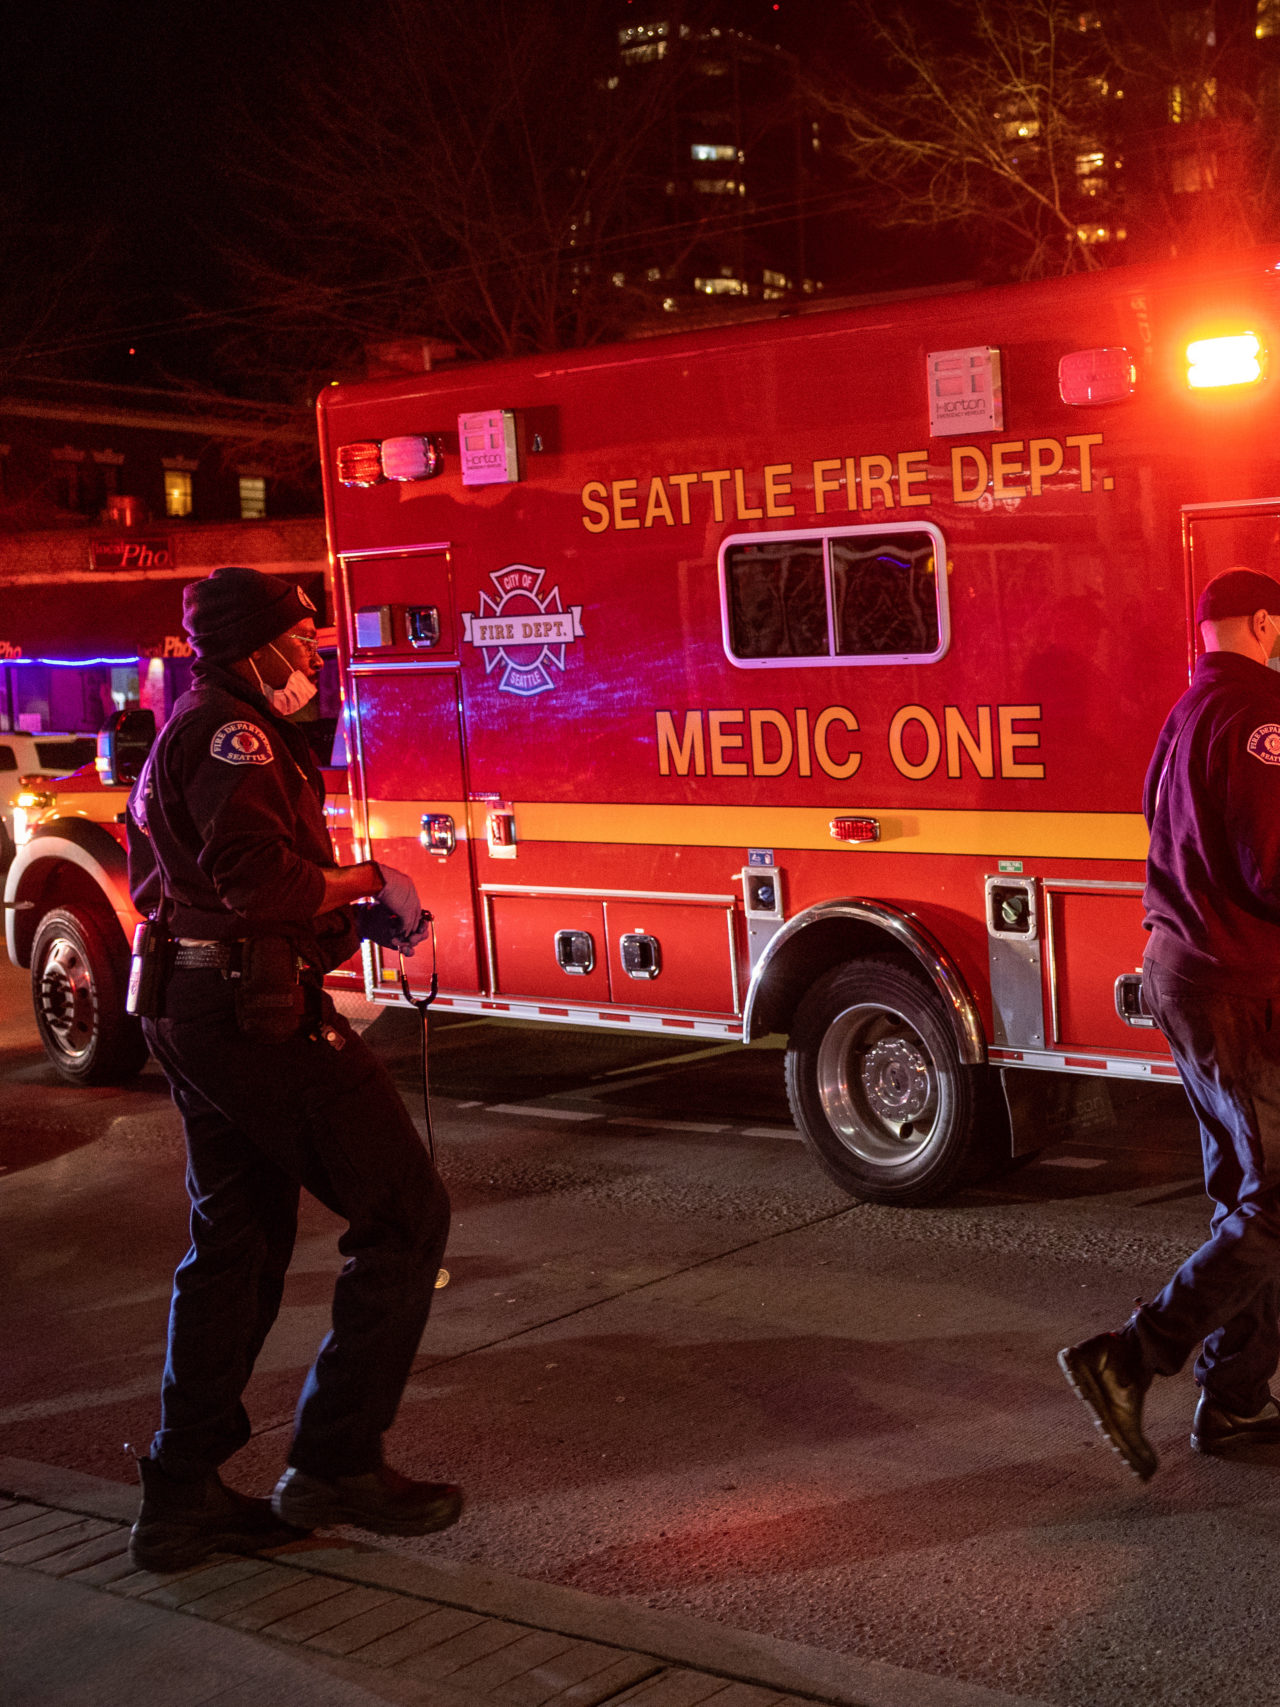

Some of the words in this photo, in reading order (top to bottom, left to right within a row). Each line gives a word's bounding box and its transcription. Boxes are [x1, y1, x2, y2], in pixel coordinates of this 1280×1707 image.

[936, 398, 986, 412] Horton
[581, 463, 796, 535] SEATTLE
[813, 450, 932, 515] FIRE
[950, 433, 1115, 504] DEPT.
[119, 543, 170, 567] Pho
[503, 573, 520, 590] CITY
[522, 574, 533, 588] OF
[480, 623, 514, 641] FIRE
[521, 621, 567, 639] DEPT.
[509, 671, 541, 688] SEATTLE
[213, 732, 226, 753] FIRE
[655, 704, 862, 781] MEDIC
[888, 704, 1046, 781] ONE
[1250, 732, 1261, 750] FIRE
